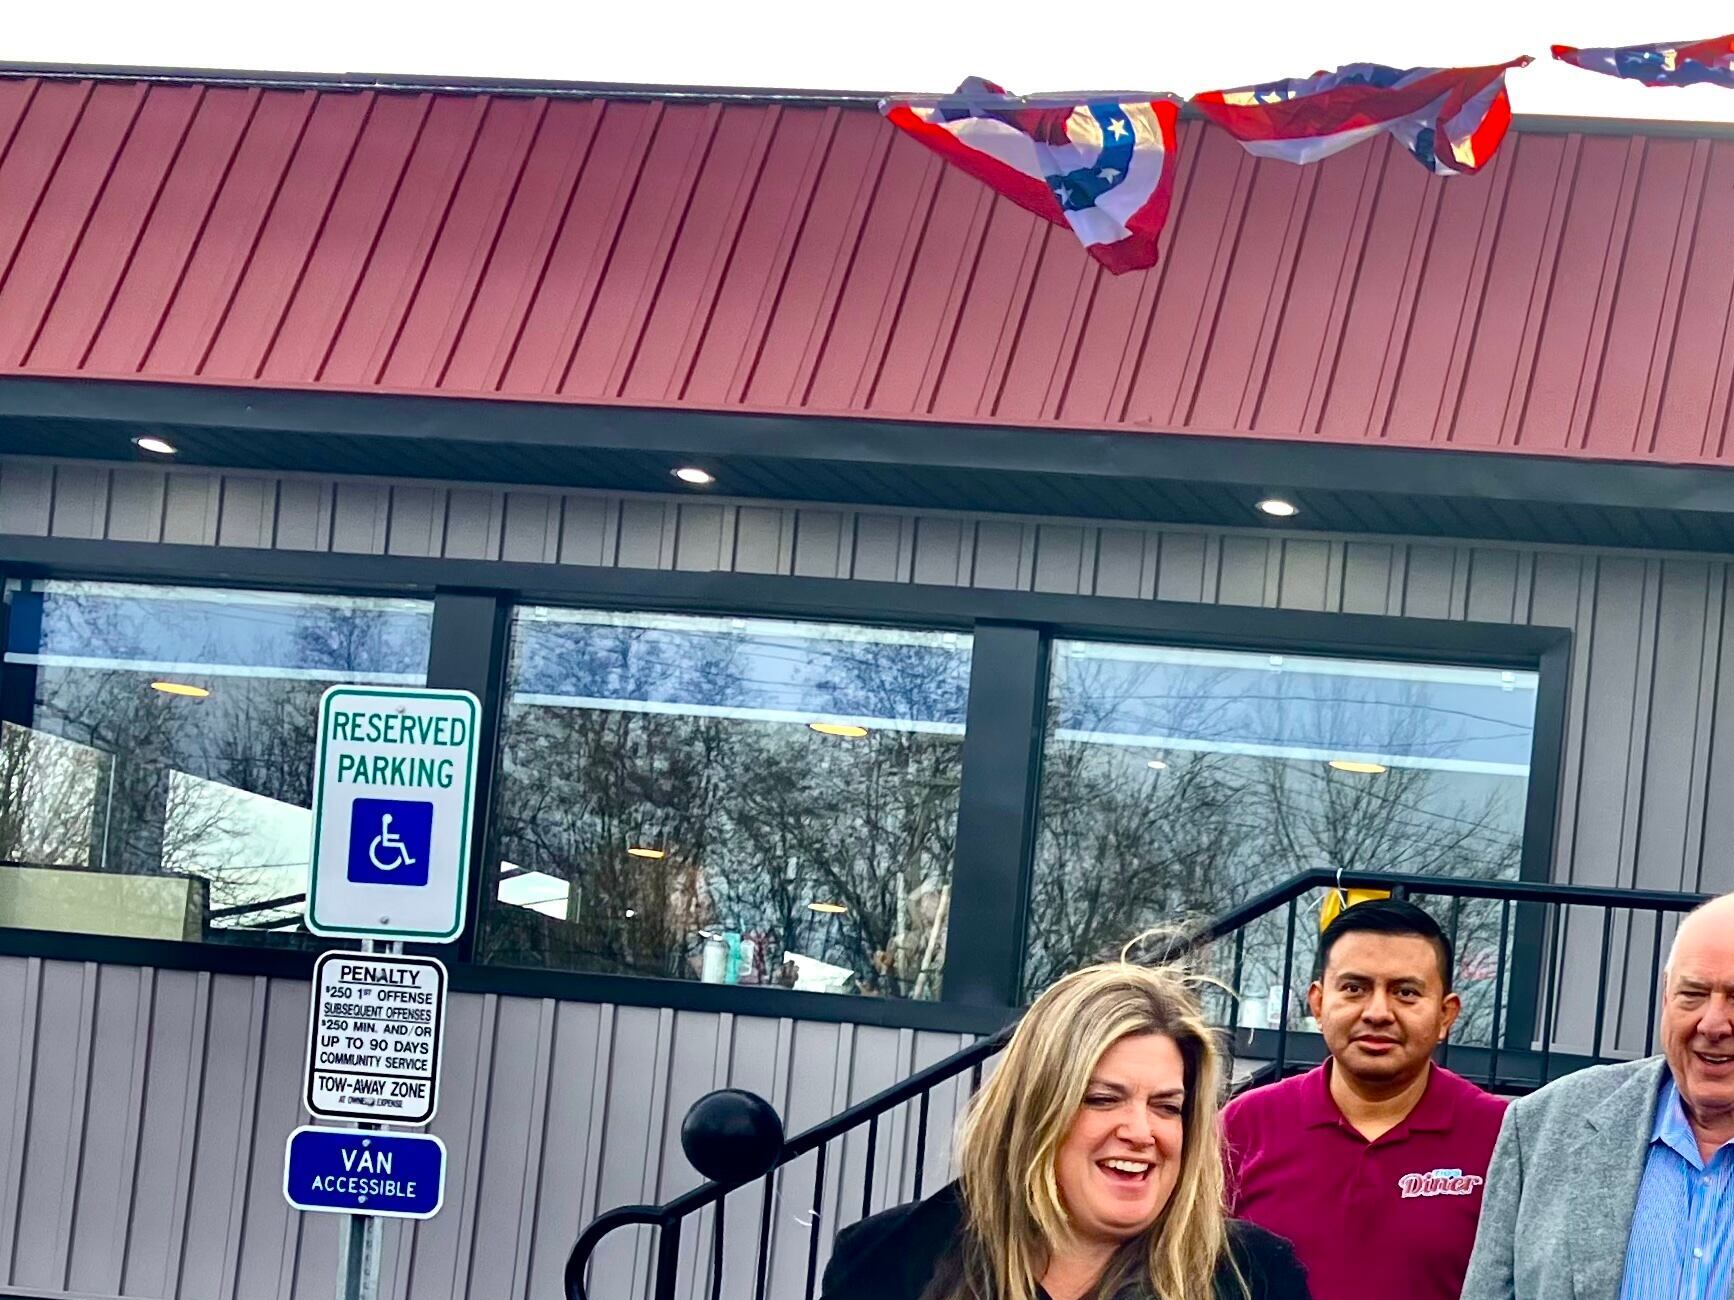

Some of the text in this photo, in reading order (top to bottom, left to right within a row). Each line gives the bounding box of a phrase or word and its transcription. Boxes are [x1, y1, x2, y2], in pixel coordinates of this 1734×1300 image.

[332, 712, 466, 747] RESERVED
[337, 754, 454, 788] PARKING
[341, 965, 420, 985] PENALTY
[325, 985, 352, 999] $250
[377, 989, 433, 1005] OFFENSE
[324, 1002, 432, 1021] SUBSEQUENT OFFENSES
[321, 1019, 432, 1037] $250 MIN. AND/OR
[321, 1035, 429, 1055] UP TO 90 DAYS
[320, 1051, 428, 1071] COMMUNITY SERVICE
[318, 1075, 426, 1098] TOW-AWAY ZONE
[341, 1148, 393, 1175] VAN
[311, 1175, 417, 1198] ACCESSIBLE
[1398, 1171, 1483, 1198] Diner
